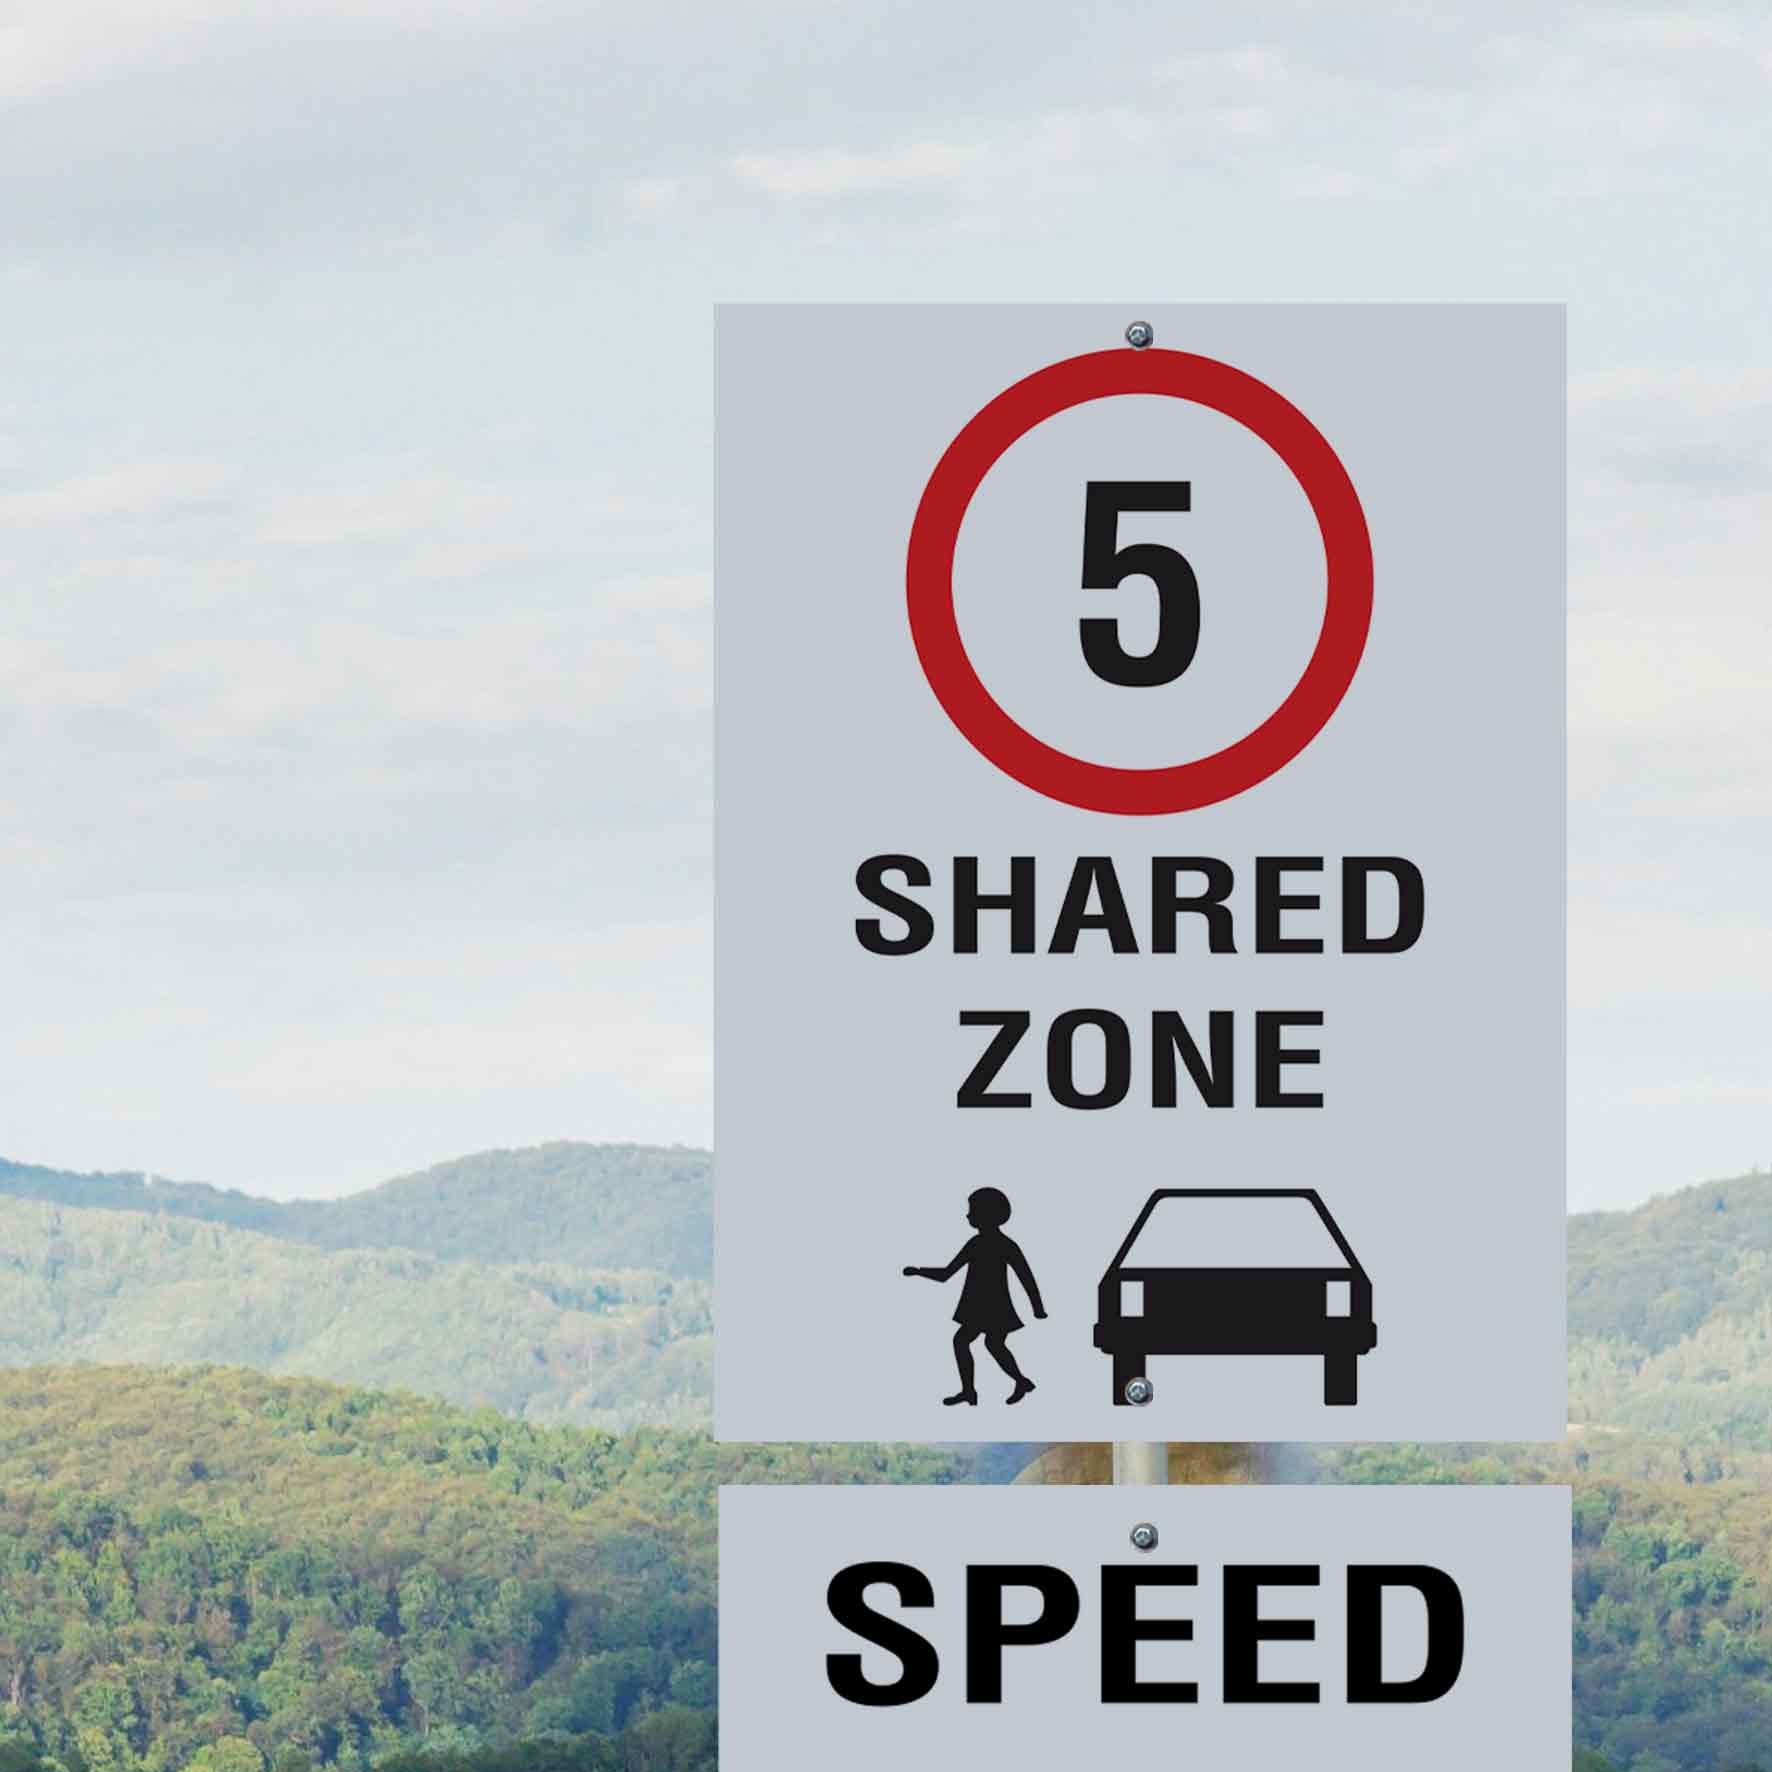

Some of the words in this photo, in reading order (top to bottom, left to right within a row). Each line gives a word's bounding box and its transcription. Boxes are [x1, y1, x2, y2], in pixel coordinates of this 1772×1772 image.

[1080, 482, 1200, 687] 5
[856, 855, 1424, 955] SHARED
[957, 1009, 1323, 1110] ZONE
[827, 1562, 1464, 1706] SPEED
